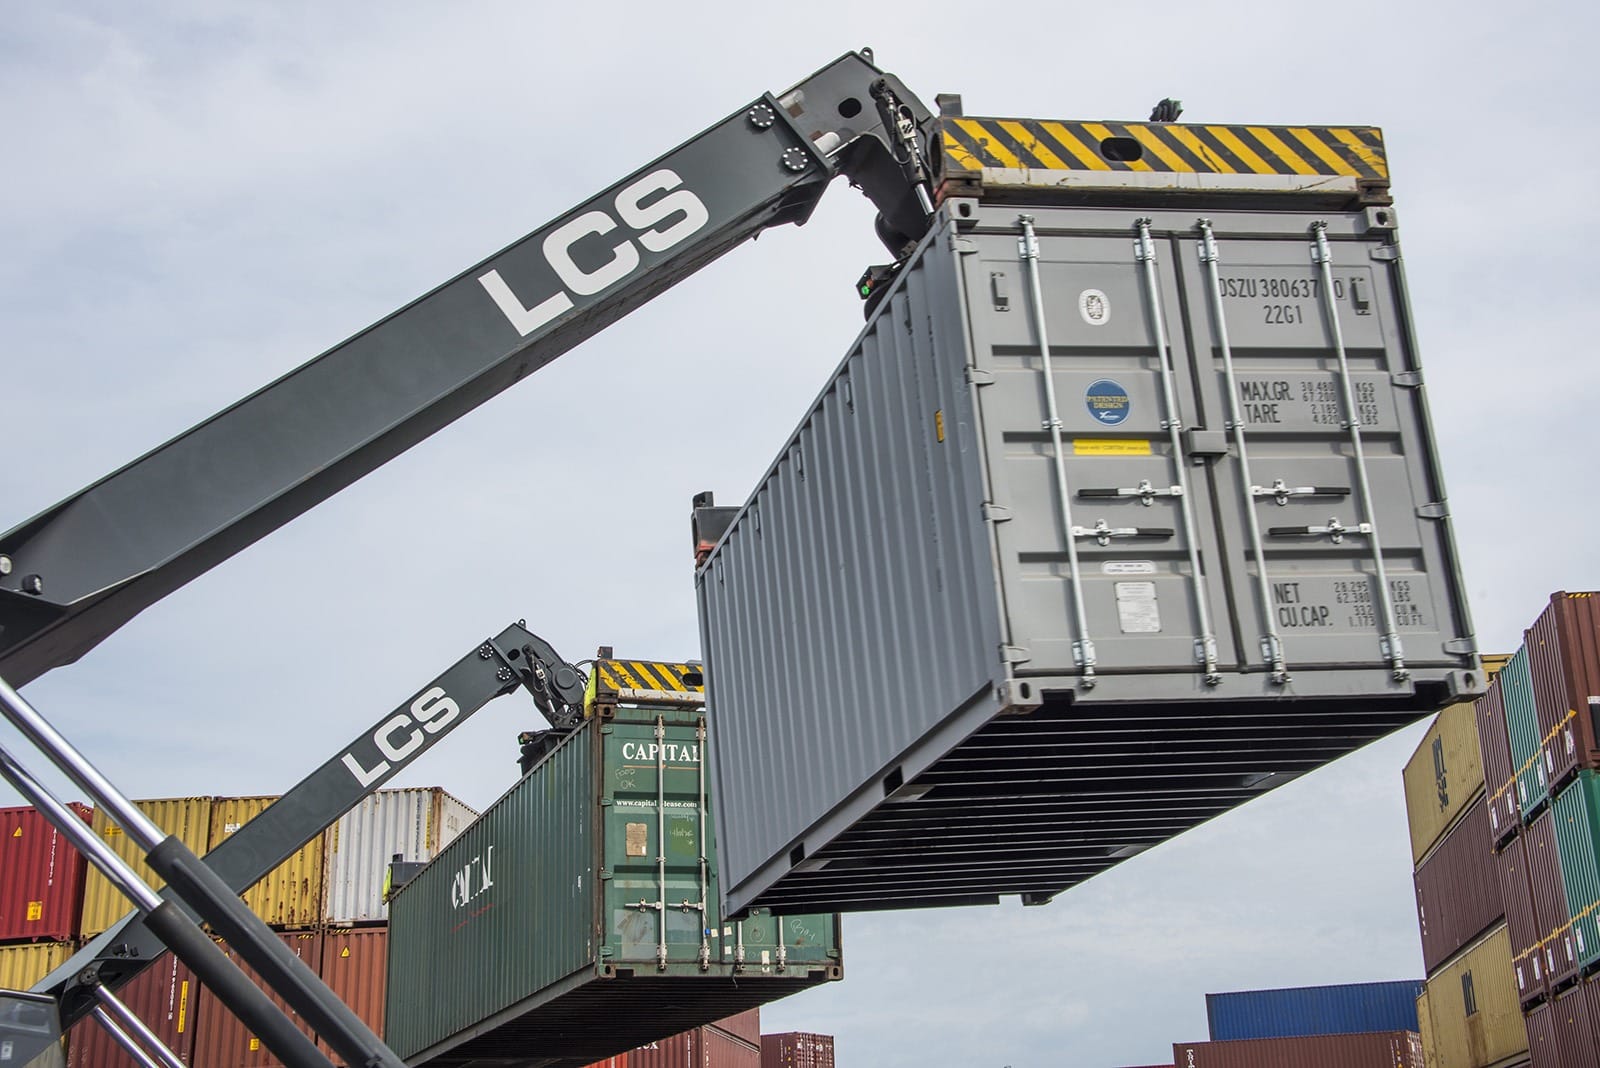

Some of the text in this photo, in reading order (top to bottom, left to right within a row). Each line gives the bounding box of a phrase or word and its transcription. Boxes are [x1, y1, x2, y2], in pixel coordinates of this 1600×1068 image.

[478, 169, 709, 337] LCS
[1261, 279, 1319, 299] 380637
[1263, 304, 1303, 325] 22G1
[1355, 382, 1375, 393] KGS
[1357, 392, 1375, 403] LBS
[1244, 404, 1281, 423] TARE
[1359, 404, 1378, 415] KGS
[1361, 415, 1379, 425] LBS
[1273, 582, 1300, 604] NET
[1391, 580, 1410, 592] KGS
[1392, 591, 1410, 603] LBS
[341, 686, 460, 788] LCS
[622, 742, 701, 762] CAPITAL
